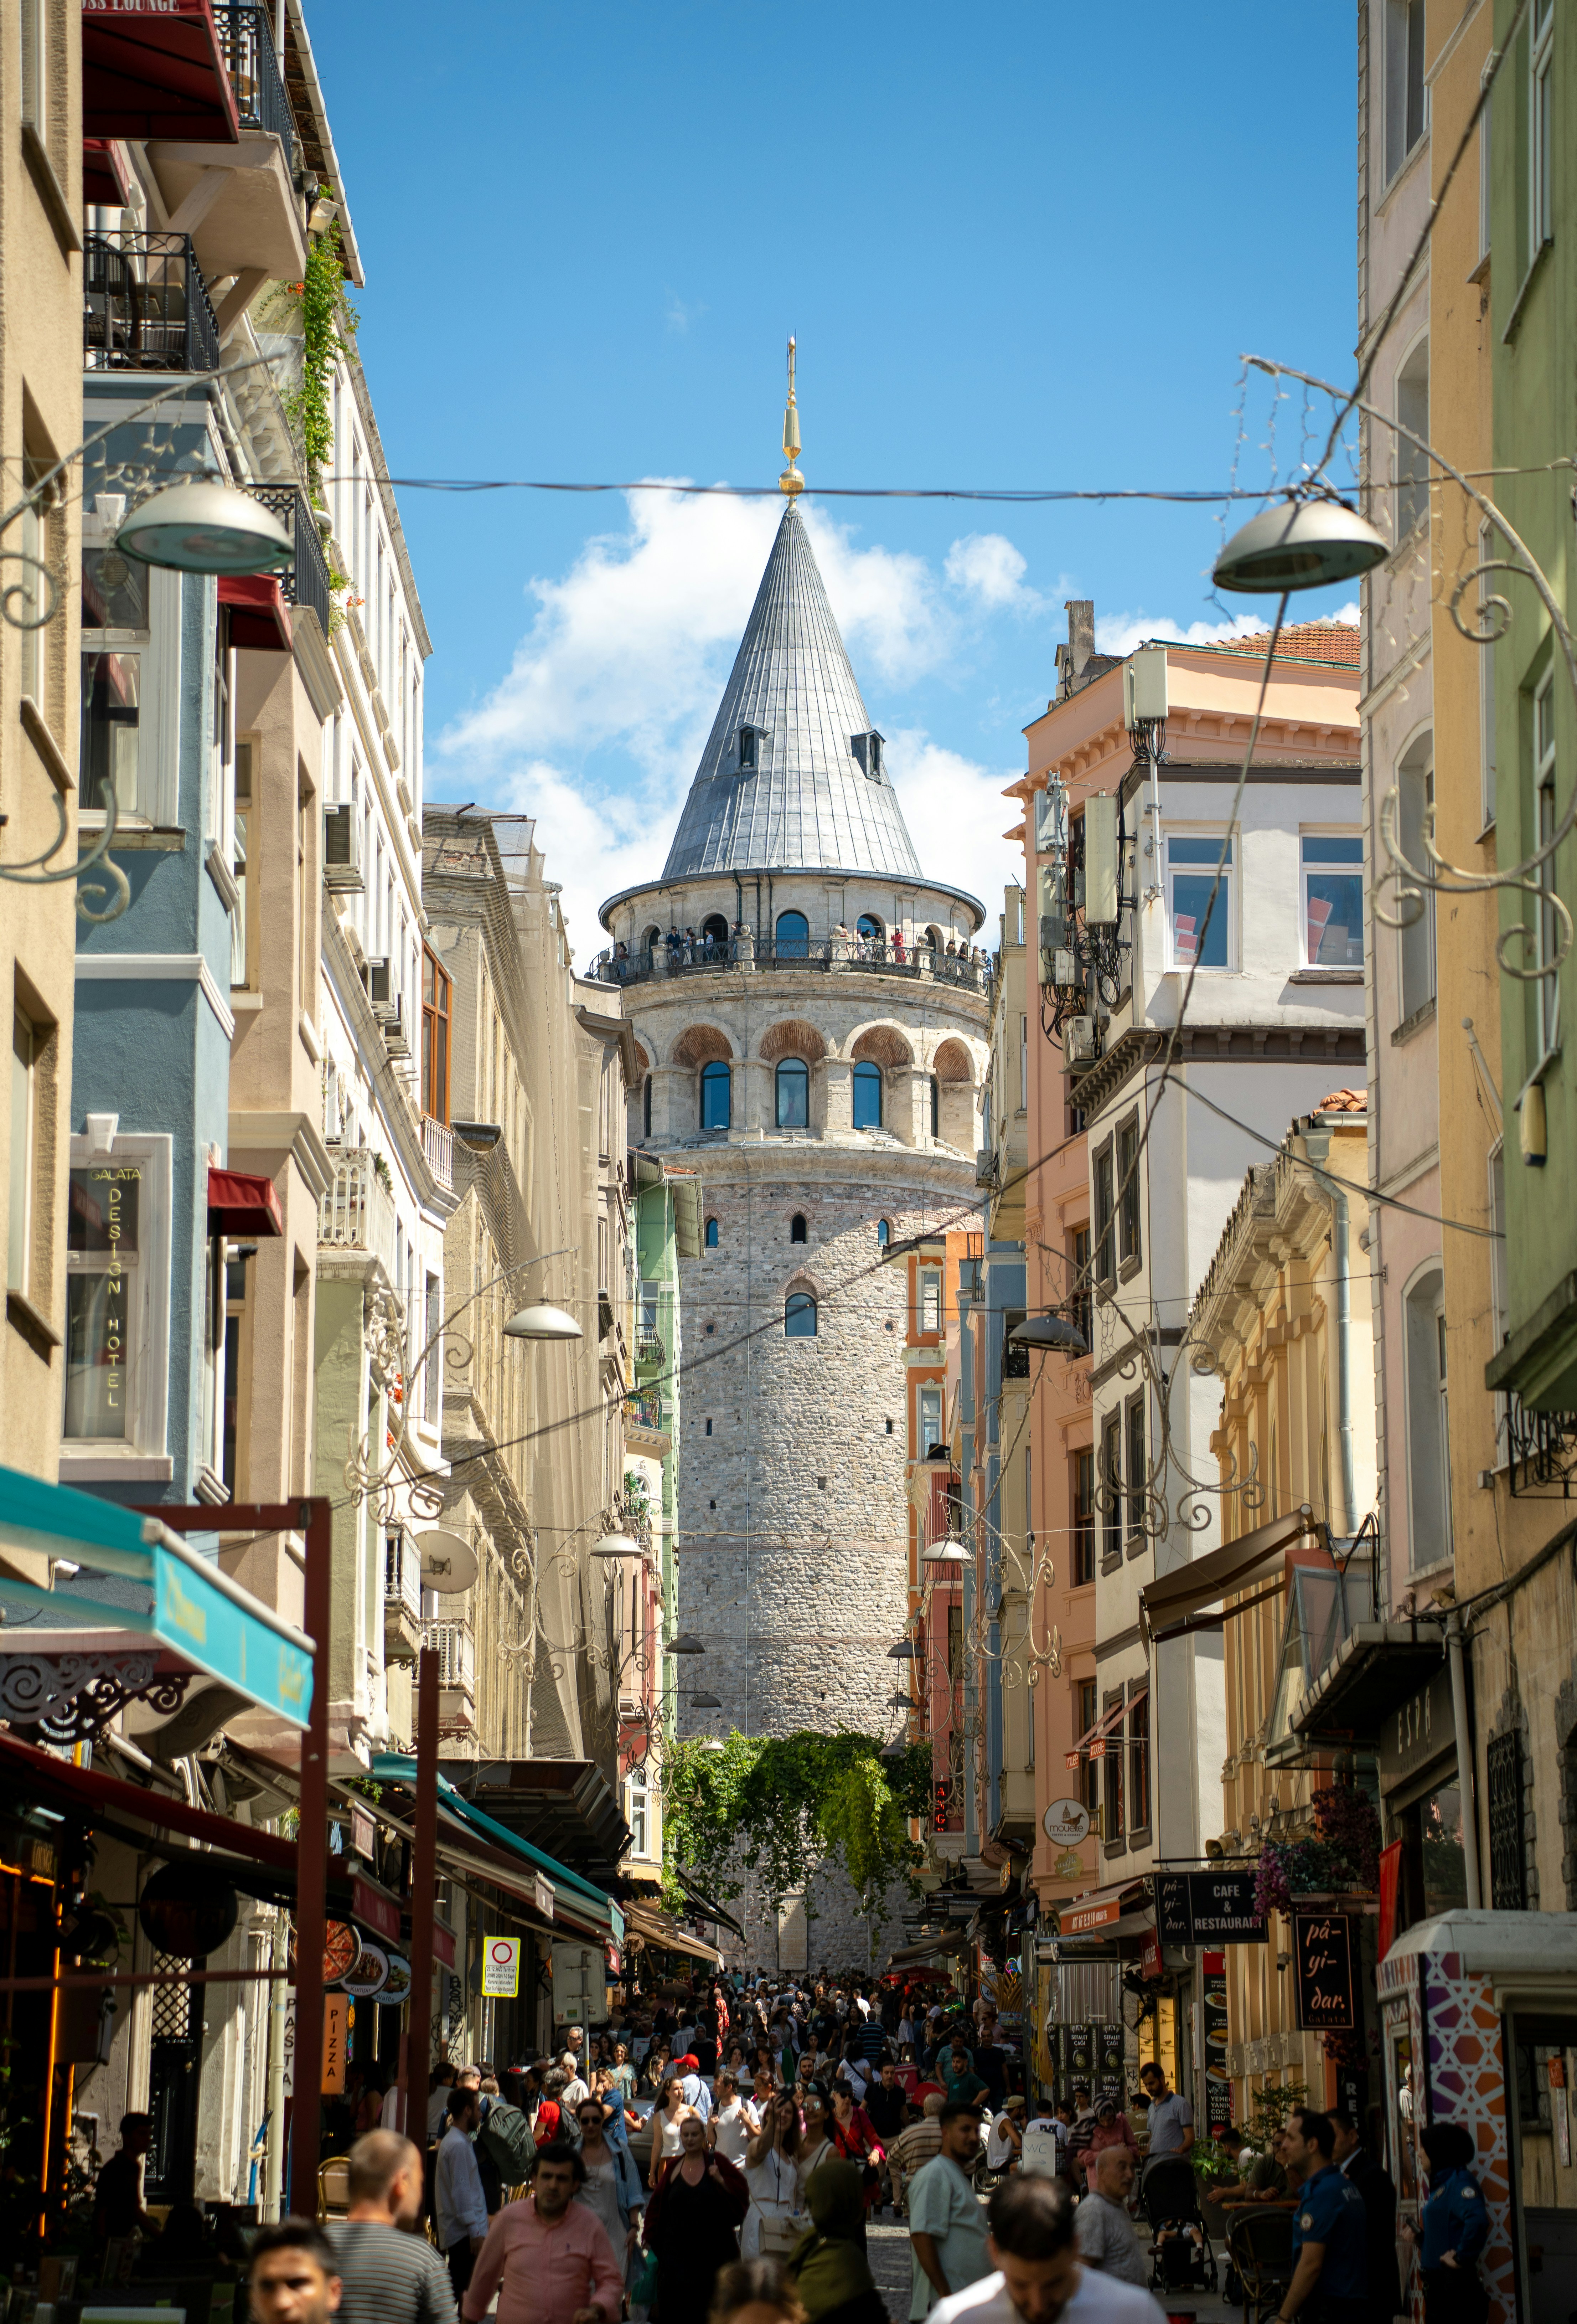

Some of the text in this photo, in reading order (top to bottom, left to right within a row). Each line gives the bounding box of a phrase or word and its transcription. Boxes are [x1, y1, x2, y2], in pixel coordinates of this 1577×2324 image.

[112, 0, 180, 12] LOUNGE
[91, 1169, 141, 1181] GALATA
[108, 1189, 121, 1294] DESIGN
[107, 1319, 120, 1407] HOTEL
[1091, 1741, 1104, 1757] mouette
[1213, 1885, 1240, 1898] CAFE
[1223, 1901, 1232, 1913] &
[376, 1994, 395, 2002] Waffle
[1308, 2013, 1346, 2024] Galata
[283, 1998, 296, 2085] PASTA
[1024, 2142, 1048, 2154] WC
